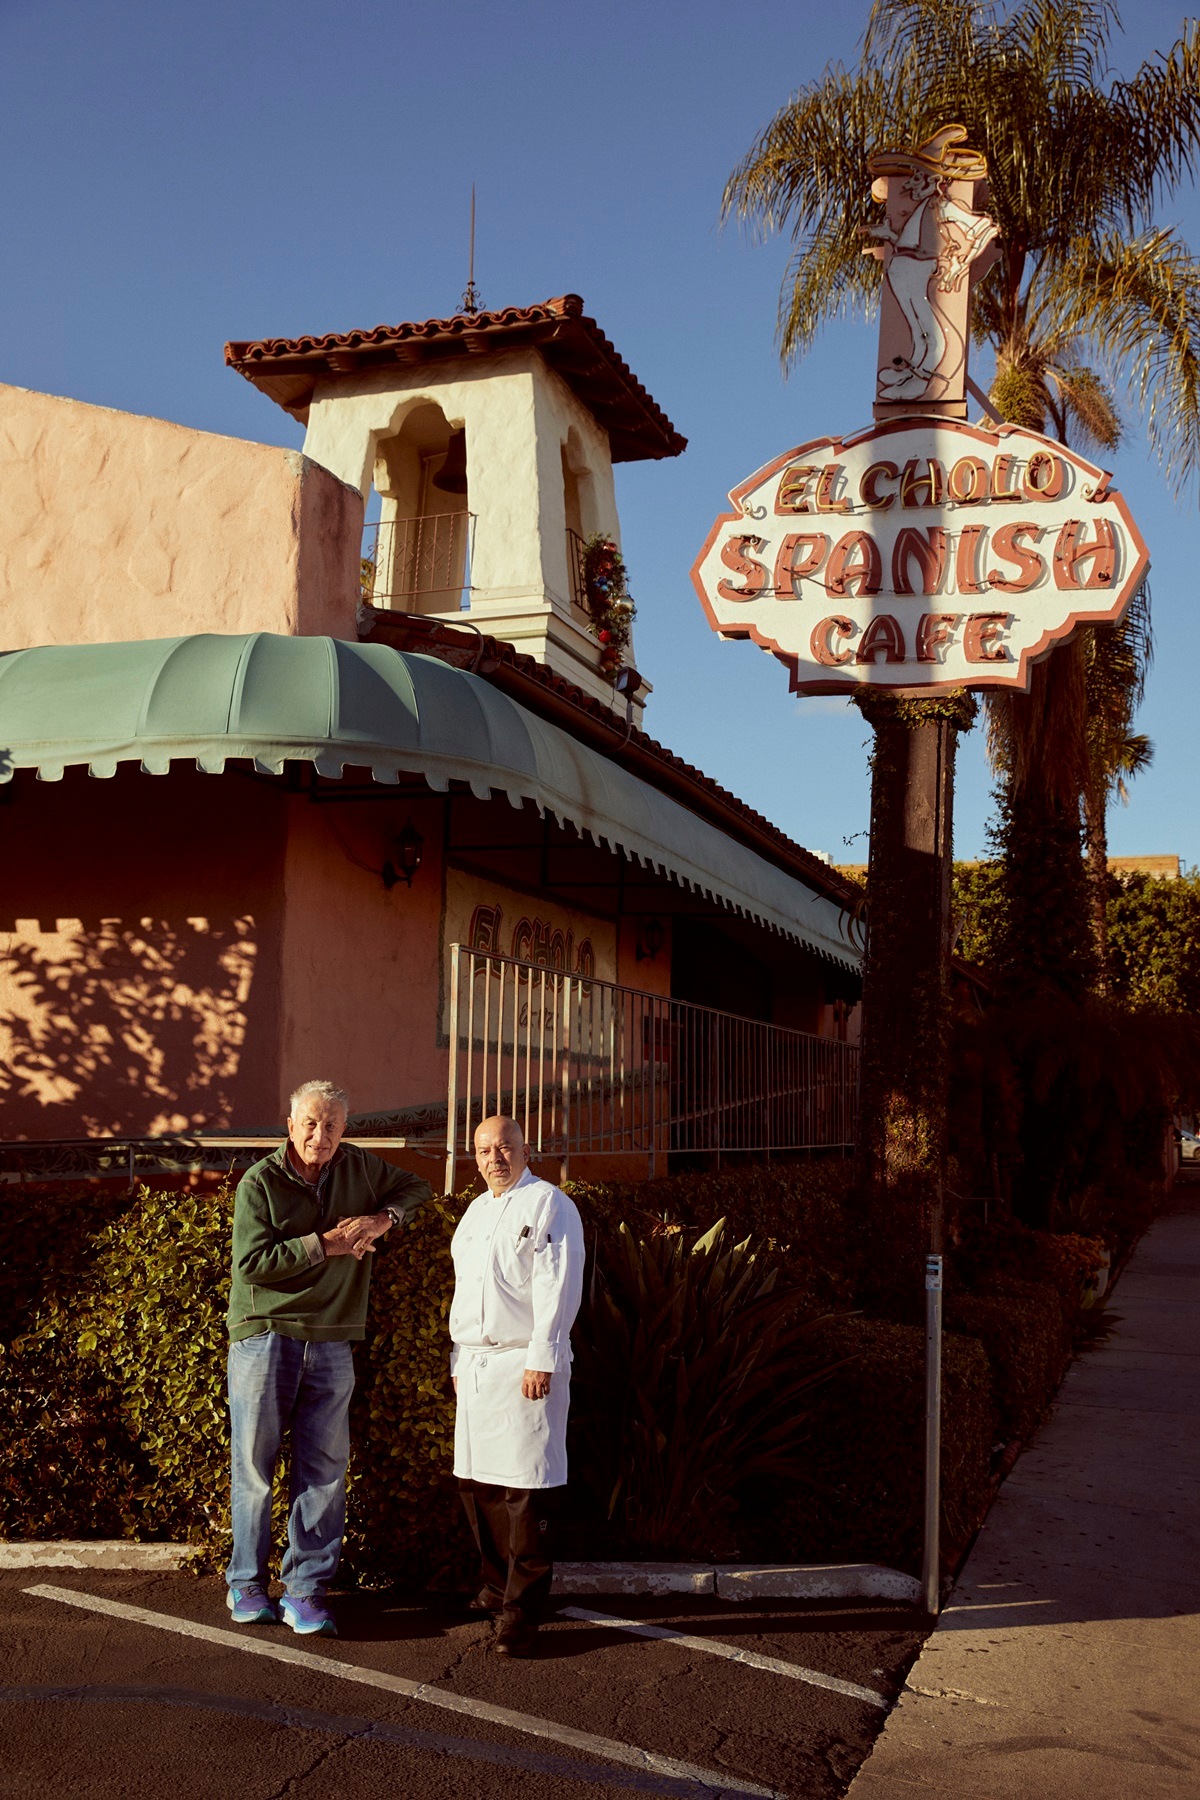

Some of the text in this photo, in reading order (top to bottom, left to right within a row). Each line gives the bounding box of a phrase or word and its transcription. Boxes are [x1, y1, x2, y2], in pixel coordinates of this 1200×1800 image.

[774, 451, 1064, 516] EL CHOLO
[717, 518, 1117, 601] SPANISH
[809, 611, 1014, 667] CAFE
